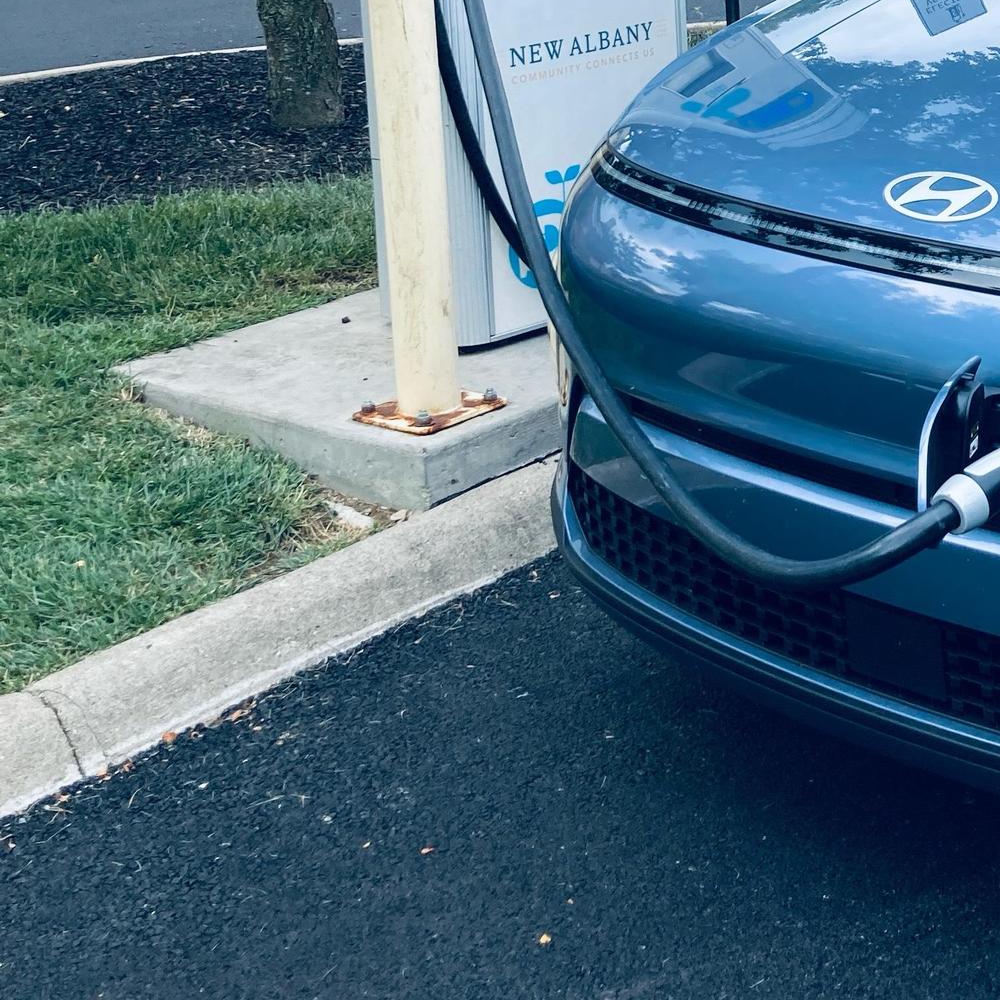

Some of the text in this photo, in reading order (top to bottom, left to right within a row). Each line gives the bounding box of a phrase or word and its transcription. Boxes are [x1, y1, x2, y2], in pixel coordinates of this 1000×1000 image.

[509, 21, 653, 68] NEW ALBANY
[511, 47, 655, 85] COMMUNITY CONNECTS US
